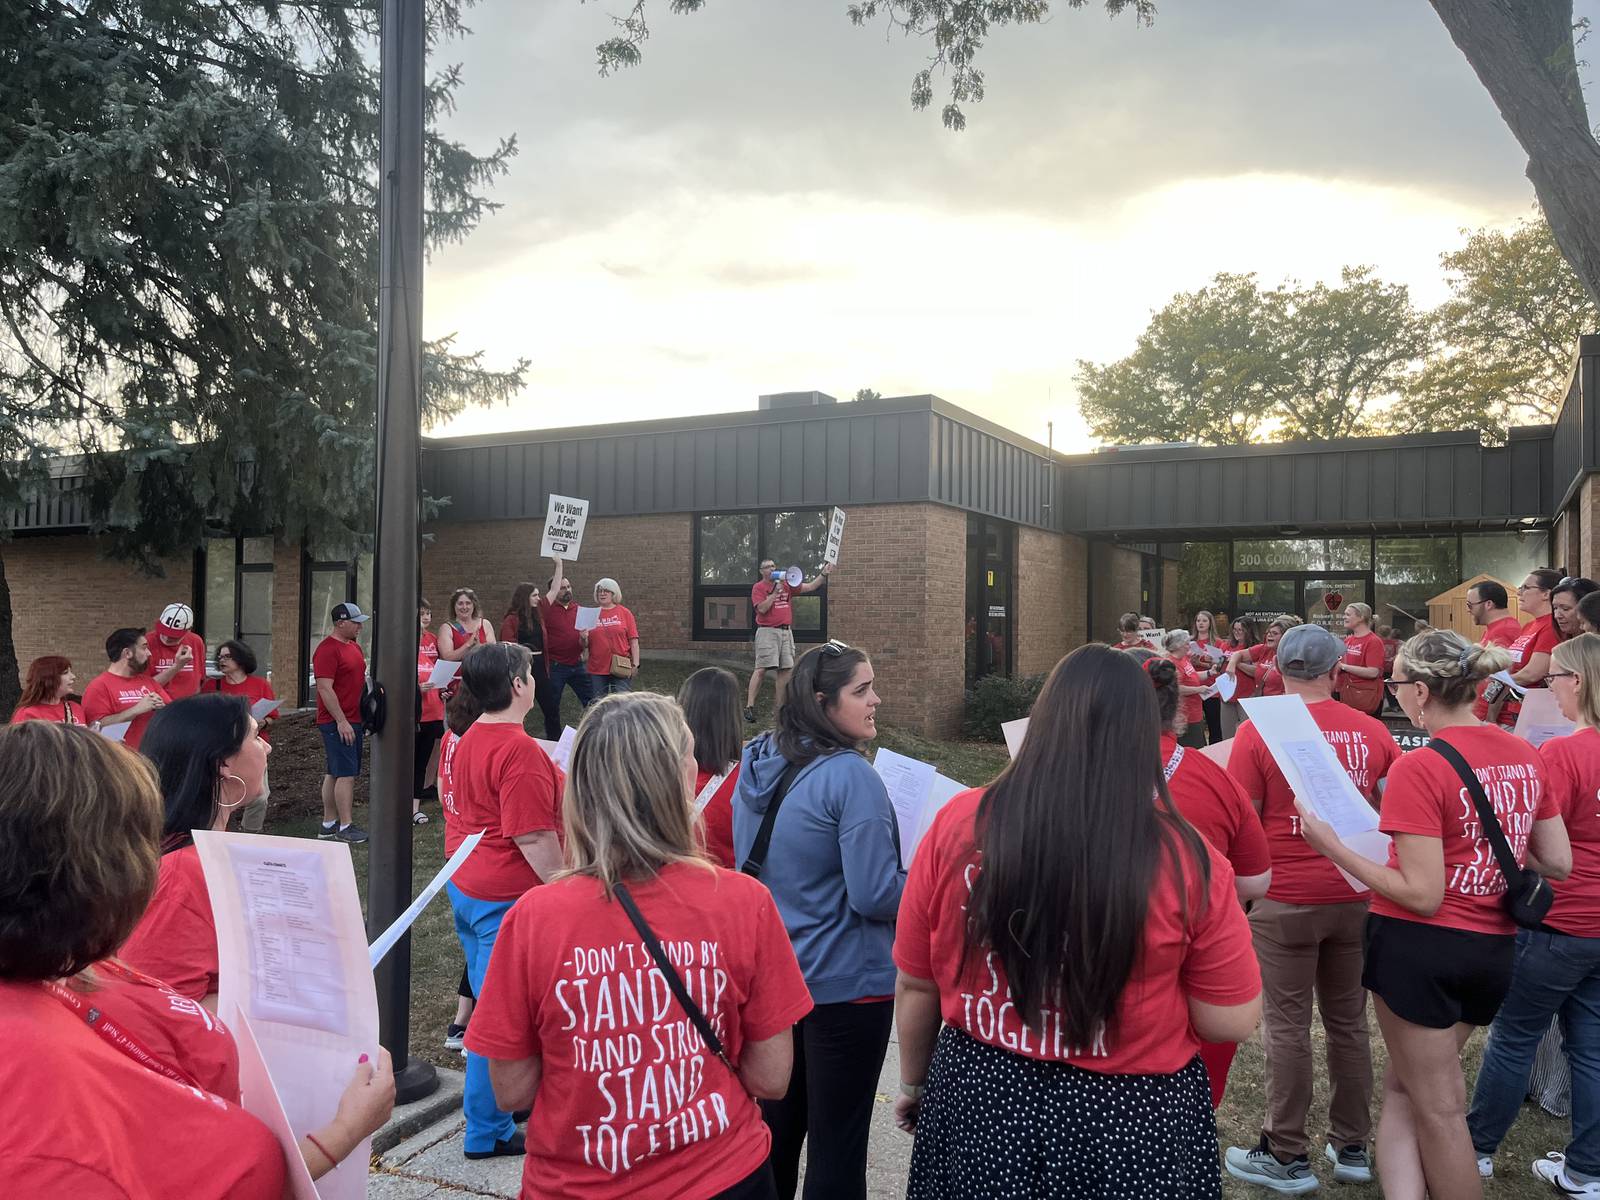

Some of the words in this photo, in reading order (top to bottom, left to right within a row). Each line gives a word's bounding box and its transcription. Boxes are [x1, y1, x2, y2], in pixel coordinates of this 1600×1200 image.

[554, 501, 565, 513] We
[566, 503, 583, 516] Want
[556, 514, 562, 525] A
[562, 515, 576, 527] Fair
[547, 525, 579, 540] Contract!
[1239, 553, 1261, 566] 300
[1243, 582, 1249, 594] 1
[1346, 743, 1369, 770] UP
[1347, 770, 1369, 788] ONG
[1459, 780, 1516, 820] SND
[642, 940, 695, 968] SND
[555, 968, 671, 1034] STAND
[685, 967, 728, 1016] UP
[102, 1021, 120, 1038] Staff
[960, 993, 1108, 1059] TOGETHR
[116, 1034, 127, 1045] 47
[572, 1033, 642, 1073] STAND
[651, 1013, 726, 1064] STROG
[597, 1054, 705, 1124] STAND
